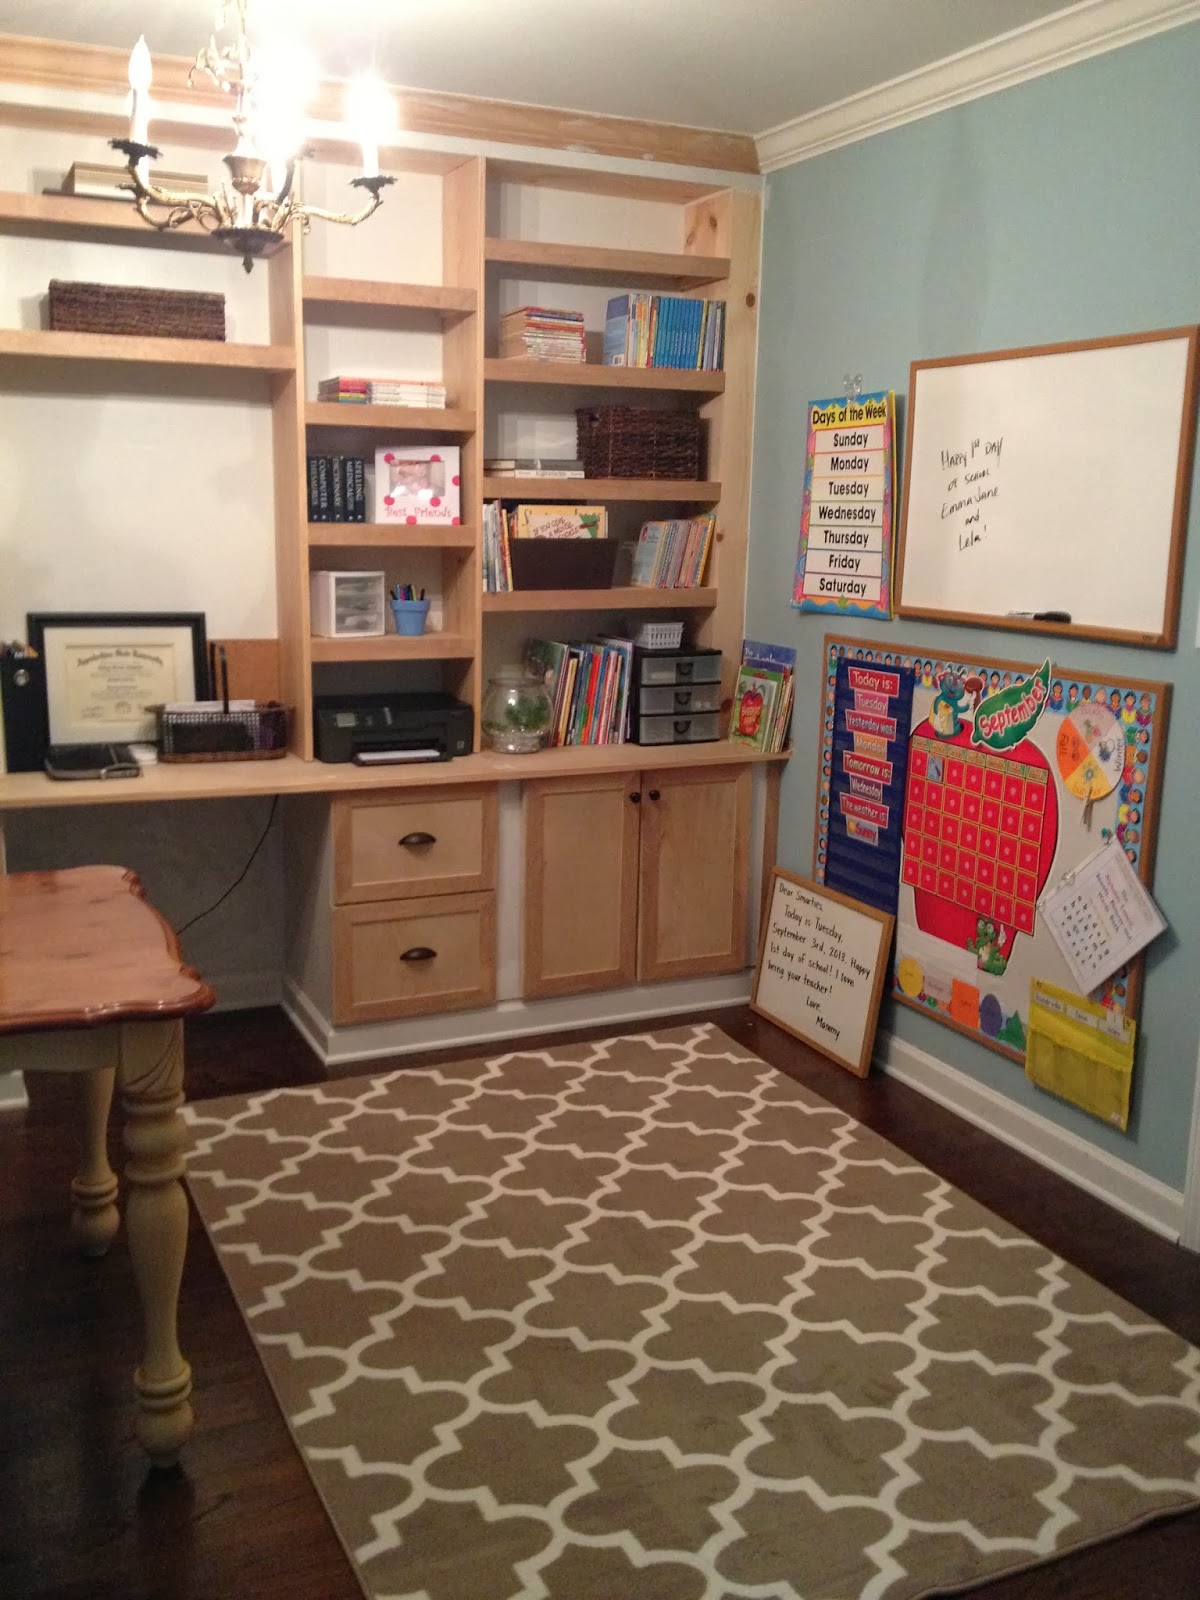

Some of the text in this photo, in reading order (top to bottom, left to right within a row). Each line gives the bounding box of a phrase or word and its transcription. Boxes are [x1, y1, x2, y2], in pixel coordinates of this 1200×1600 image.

[813, 403, 887, 427] Days of the Week
[833, 432, 869, 448] Sunday
[830, 456, 869, 472] Monday
[319, 459, 328, 509] COMPUTER
[354, 460, 363, 502] SPELLING
[828, 481, 869, 497] Tuesday
[414, 506, 452, 518] Friends
[818, 506, 876, 523] Wednesday
[824, 530, 869, 548] Thursday
[829, 554, 861, 571] Friday
[819, 578, 867, 597] Saturday
[852, 670, 893, 691] Today is:
[857, 693, 887, 713] Tuesday
[978, 677, 1047, 736] September
[847, 713, 895, 735] Yesterday was:
[856, 736, 887, 753] Monday
[845, 754, 880, 775] Tomorrow
[851, 777, 882, 800] Wednesday
[841, 796, 853, 809] The
[854, 803, 878, 818] weather
[780, 883, 793, 896] Dear
[785, 904, 802, 926] Today
[772, 922, 806, 944] September
[850, 957, 871, 980] Happy
[768, 959, 784, 979] being
[788, 970, 801, 981] your
[783, 946, 794, 962] day
[798, 952, 806, 963] of
[840, 973, 855, 987] love
[816, 1015, 840, 1041] Mommy
